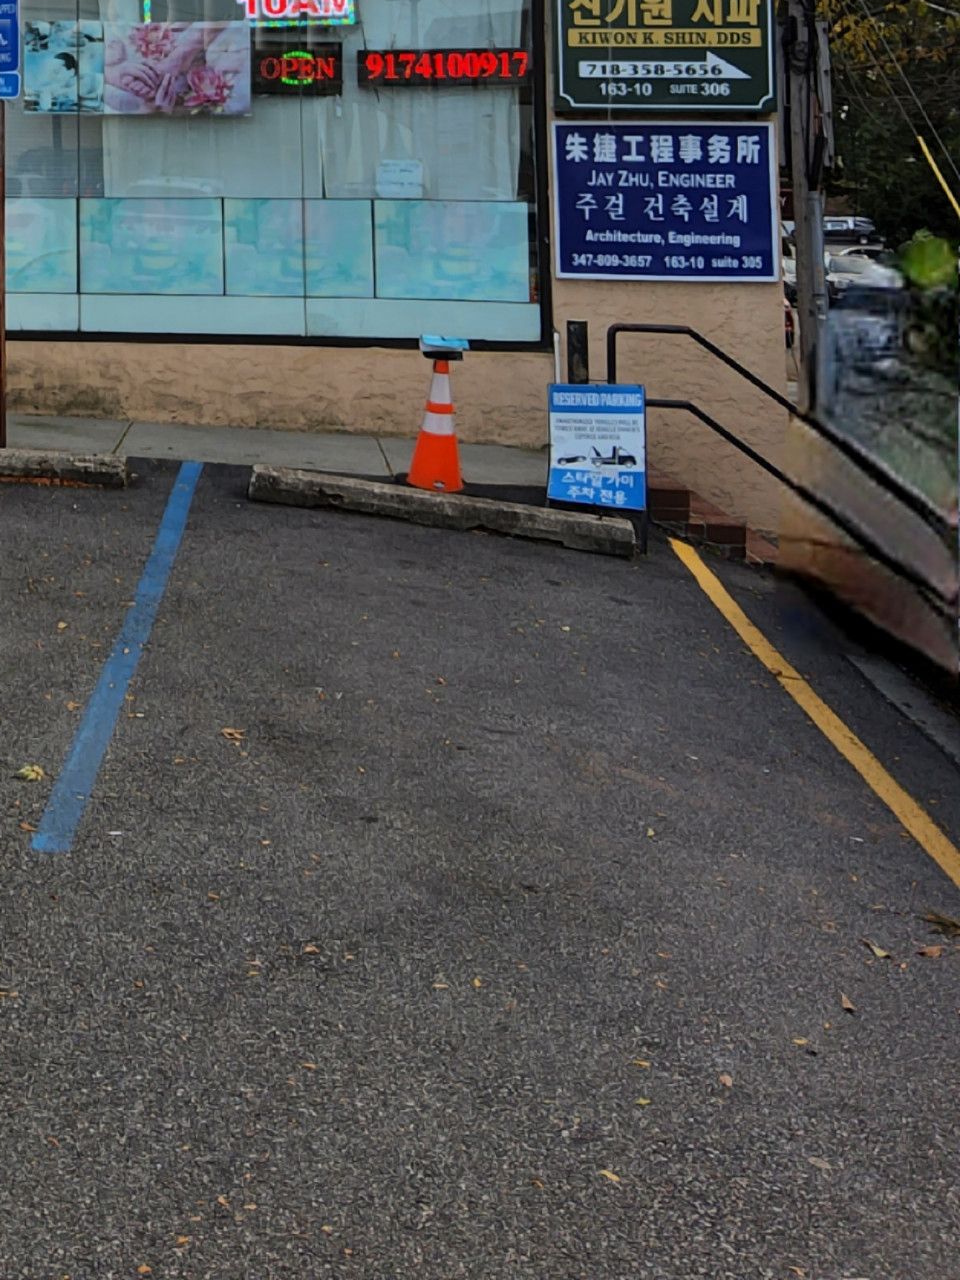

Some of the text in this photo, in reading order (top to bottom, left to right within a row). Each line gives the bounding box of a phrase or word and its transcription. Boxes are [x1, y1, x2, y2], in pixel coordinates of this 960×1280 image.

[578, 31, 638, 45] KIWON
[642, 31, 659, 45] K.
[717, 31, 752, 45] DDS
[259, 56, 336, 80] OPEN
[365, 50, 528, 80] 9174100917
[586, 63, 723, 77] 718-358-5656
[599, 83, 731, 96] 163-10 SUITE 306
[587, 170, 736, 189] JAY ZHU, ENGINEER
[575, 192, 748, 224] 주걸 건축설계
[586, 230, 741, 248] Architecture, Engineering
[571, 253, 763, 269] 347-809-3657 163-10 suite 305
[552, 392, 642, 407] RESERVED PARKING
